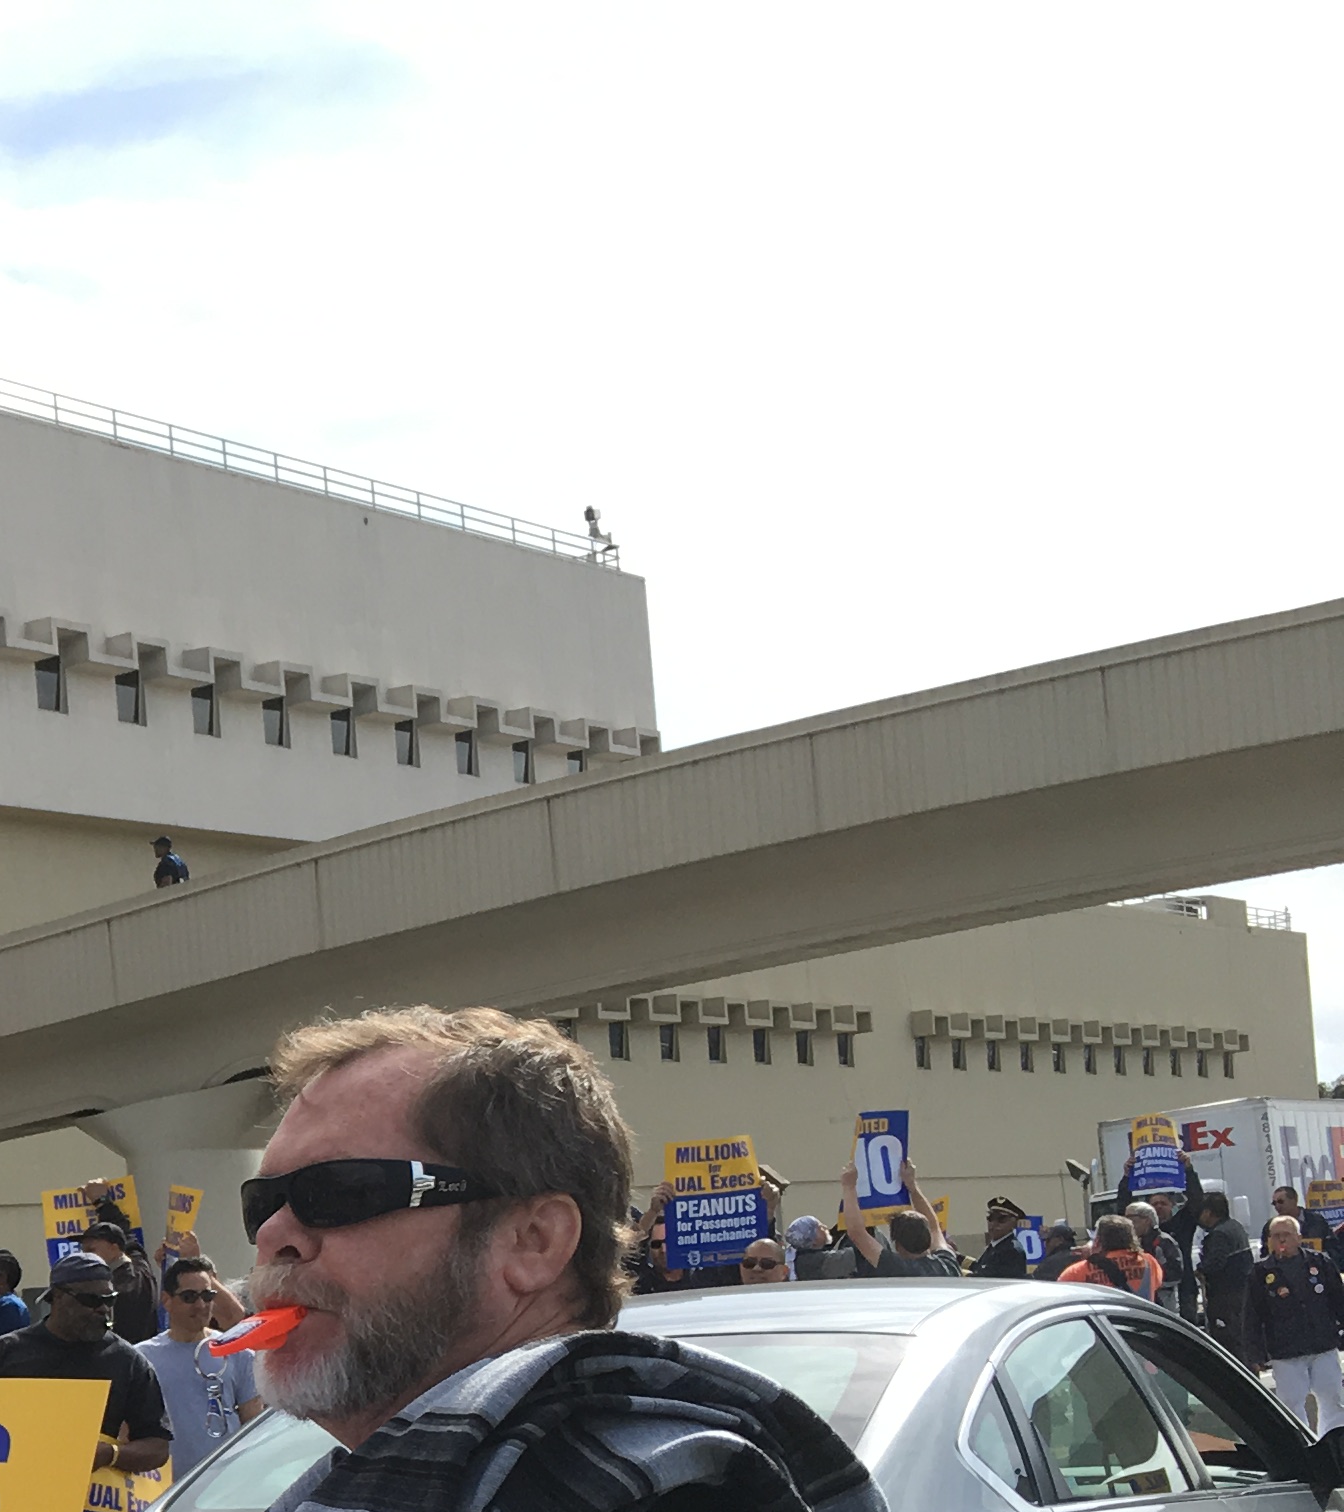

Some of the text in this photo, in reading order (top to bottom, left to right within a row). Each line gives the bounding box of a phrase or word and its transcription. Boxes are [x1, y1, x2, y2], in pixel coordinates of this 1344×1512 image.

[676, 1141, 749, 1164] MILLIONS
[1135, 1146, 1178, 1160] PEANUTS
[708, 1163, 722, 1173] for
[675, 1172, 755, 1193] UAL Execs
[54, 1183, 126, 1210] MILLNS
[676, 1193, 757, 1219] PEANUTS
[56, 1219, 84, 1235] UAL
[677, 1215, 757, 1232] for Passengers
[677, 1228, 757, 1245] and Mechanics
[88, 1483, 122, 1511] UAL
